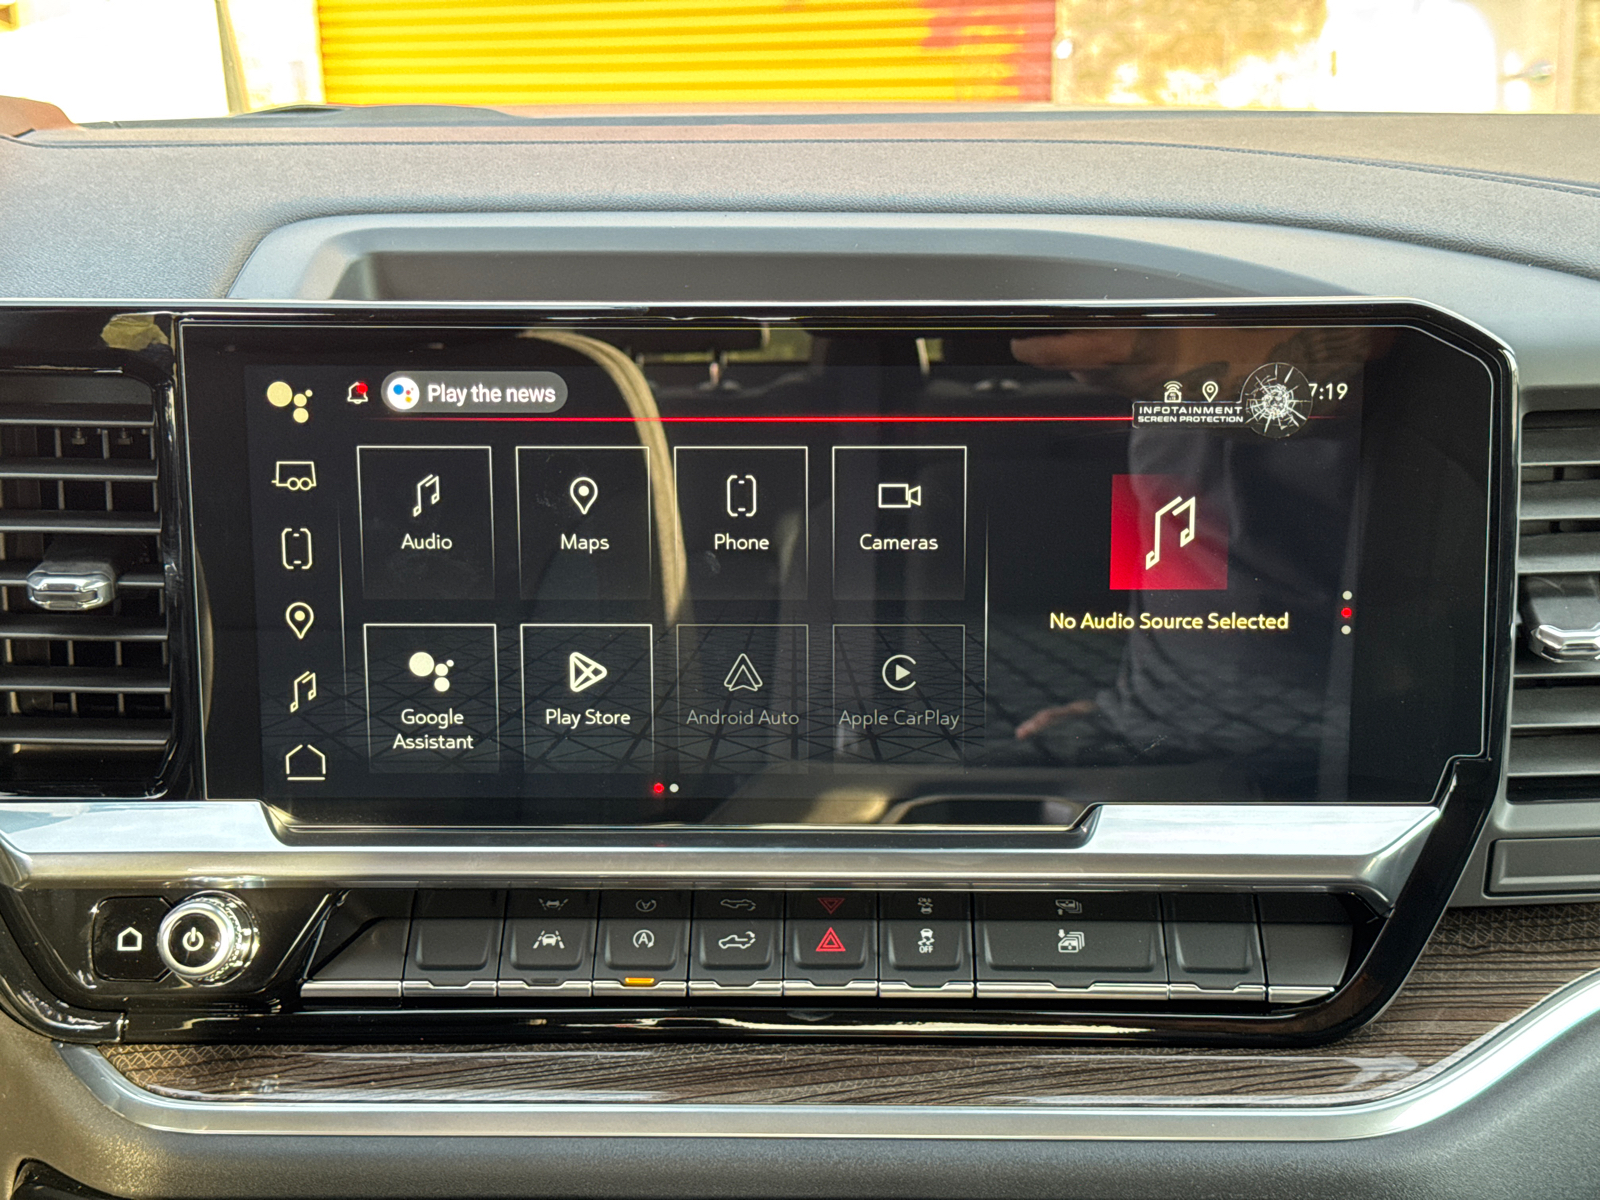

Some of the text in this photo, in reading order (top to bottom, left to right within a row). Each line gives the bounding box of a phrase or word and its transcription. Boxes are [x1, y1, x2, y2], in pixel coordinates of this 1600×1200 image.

[427, 383, 556, 406] Play the news
[1309, 383, 1348, 400] 7:19
[401, 533, 453, 551] Audio
[560, 534, 610, 554] Maps
[714, 533, 770, 550] Phone
[859, 533, 939, 550] Cameras
[1050, 611, 1289, 629] No Audio Source Selected
[401, 708, 464, 728] Google
[545, 708, 631, 729] Play Store
[686, 709, 800, 726] Android Auto
[838, 709, 960, 730] Apple CarPlay
[392, 733, 474, 749] Assistant
[918, 945, 934, 954] OFF
